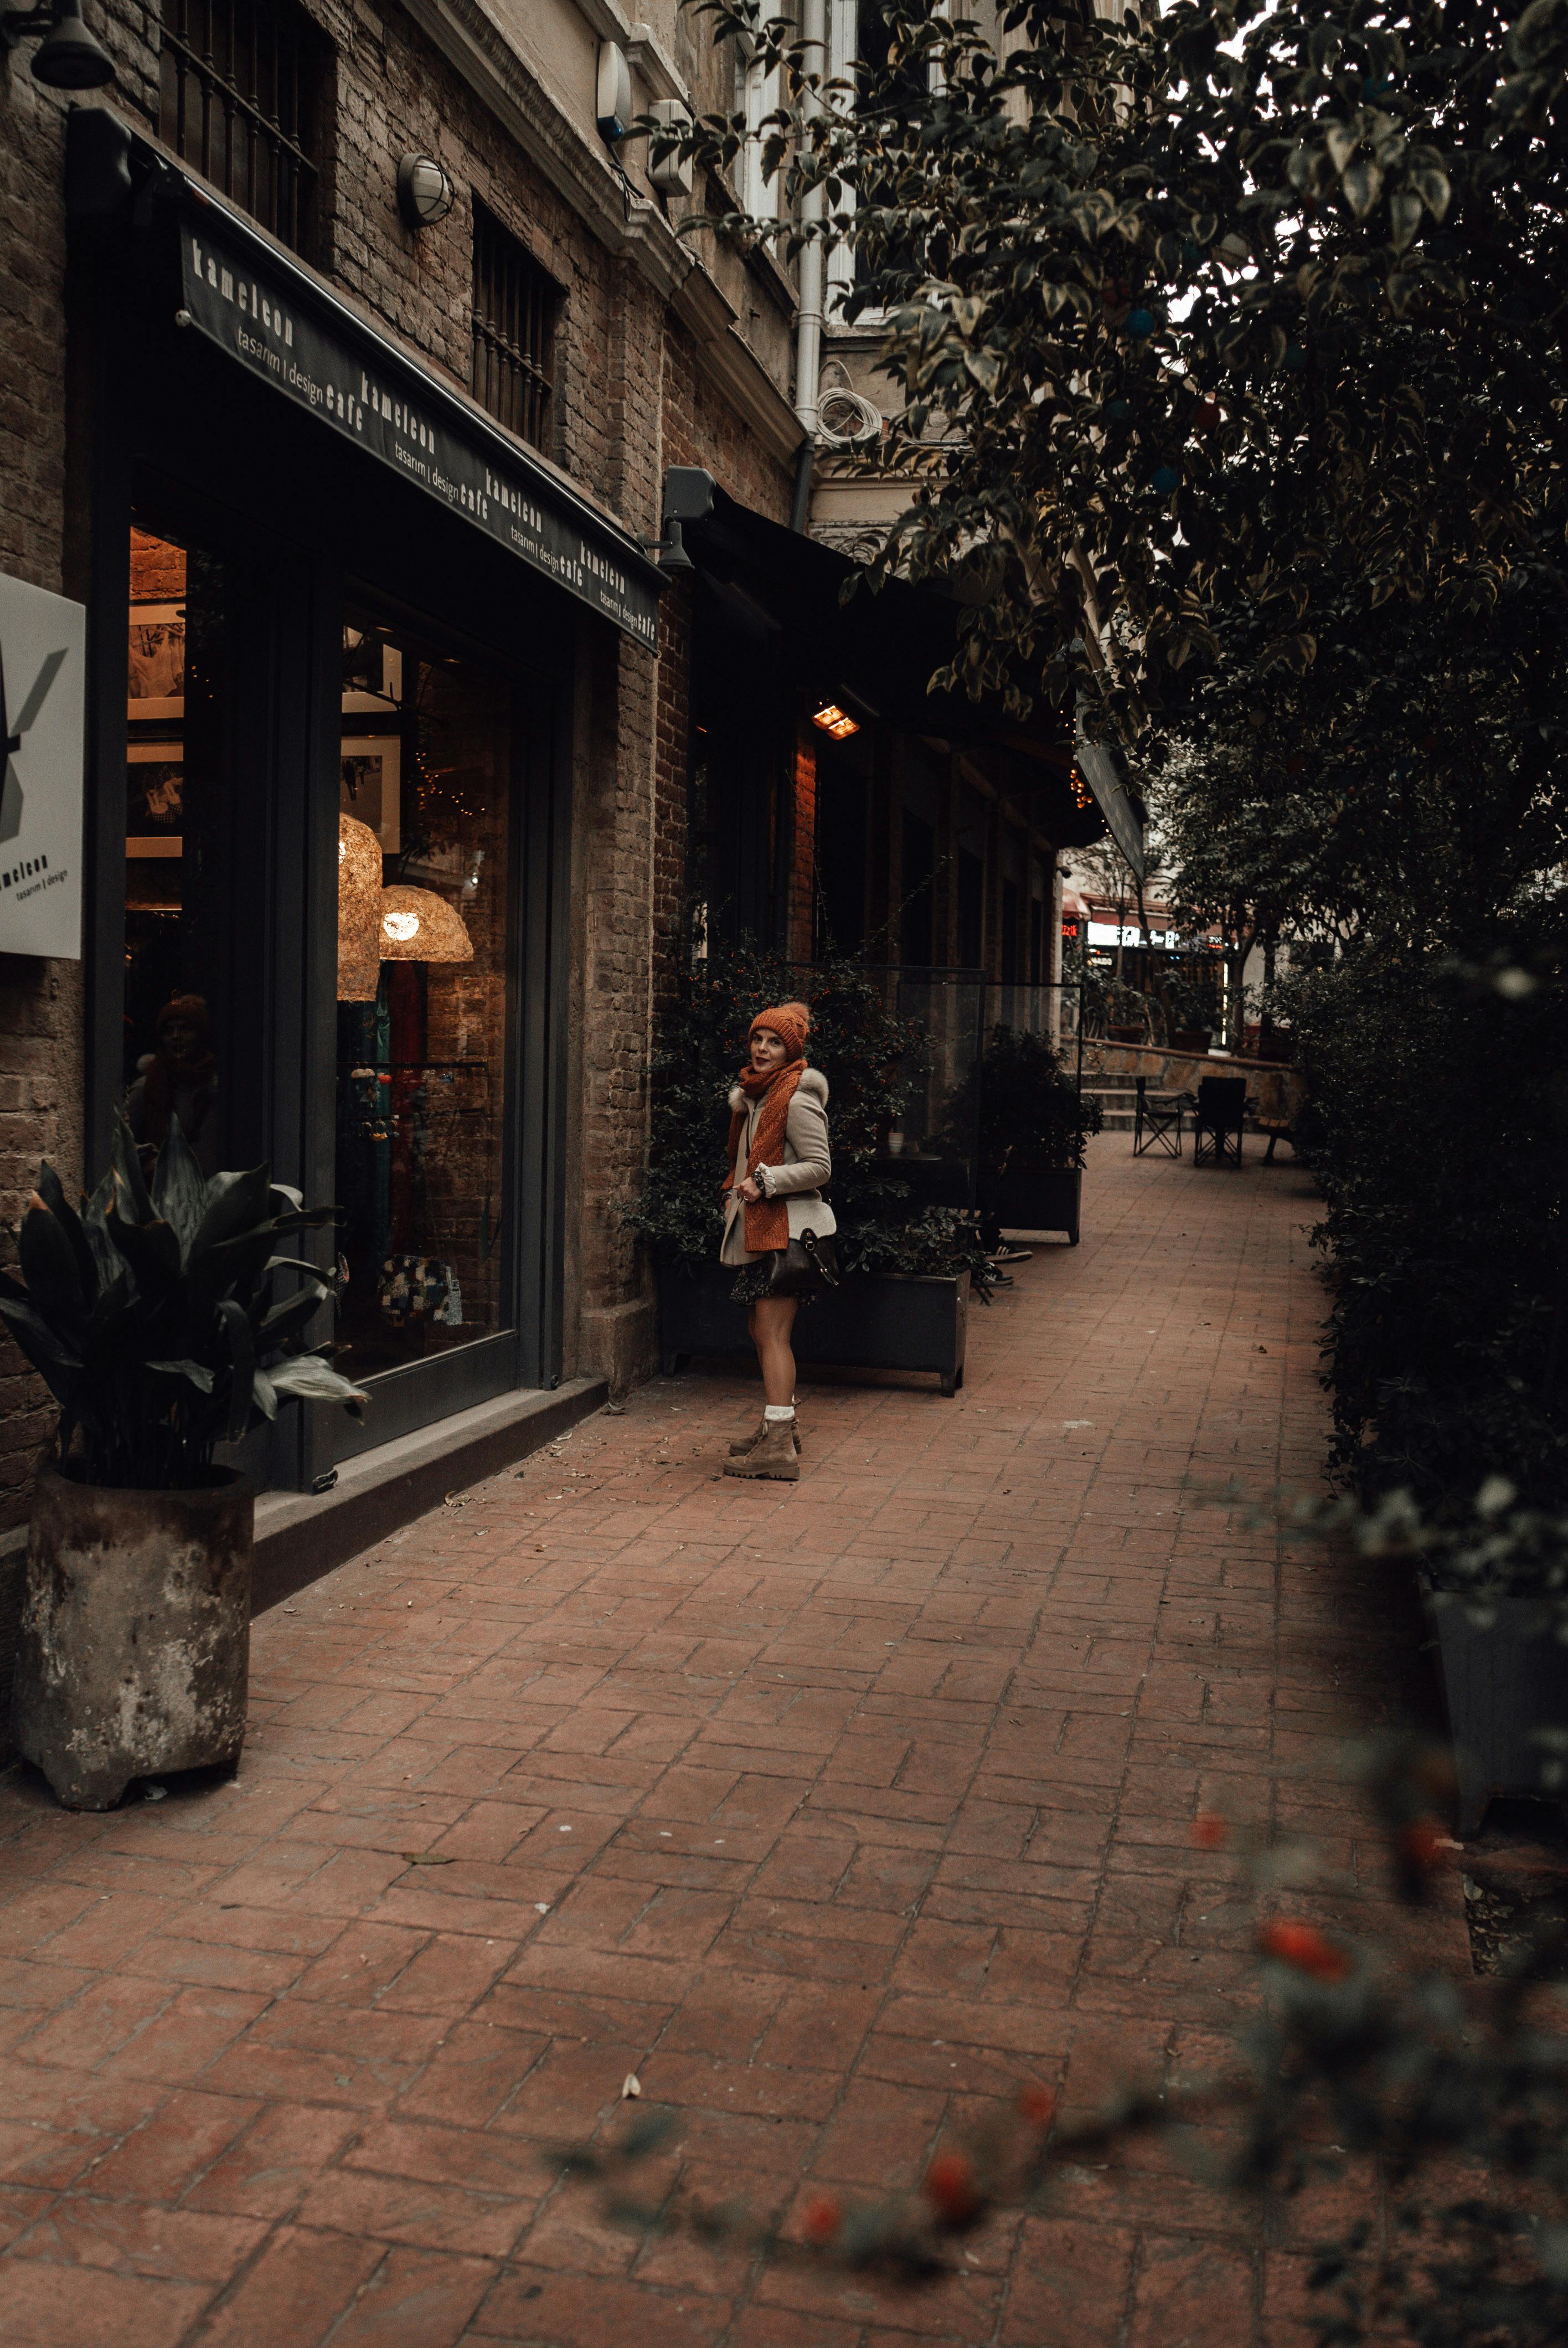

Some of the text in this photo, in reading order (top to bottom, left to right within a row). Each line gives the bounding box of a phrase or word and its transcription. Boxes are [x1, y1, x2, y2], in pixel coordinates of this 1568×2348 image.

[193, 238, 292, 347] kameleon
[239, 326, 280, 373] tasarım
[290, 363, 323, 405] design
[326, 384, 363, 431] cafe
[362, 371, 435, 455] kameleon
[395, 441, 425, 478] tasarım
[432, 466, 459, 502] design
[461, 483, 488, 519] cafe
[486, 467, 541, 533] kameleon
[540, 543, 559, 573] design
[560, 555, 582, 586] cafe
[622, 604, 637, 629] design
[638, 613, 655, 641] cafe
[0, 854, 47, 891] meleon
